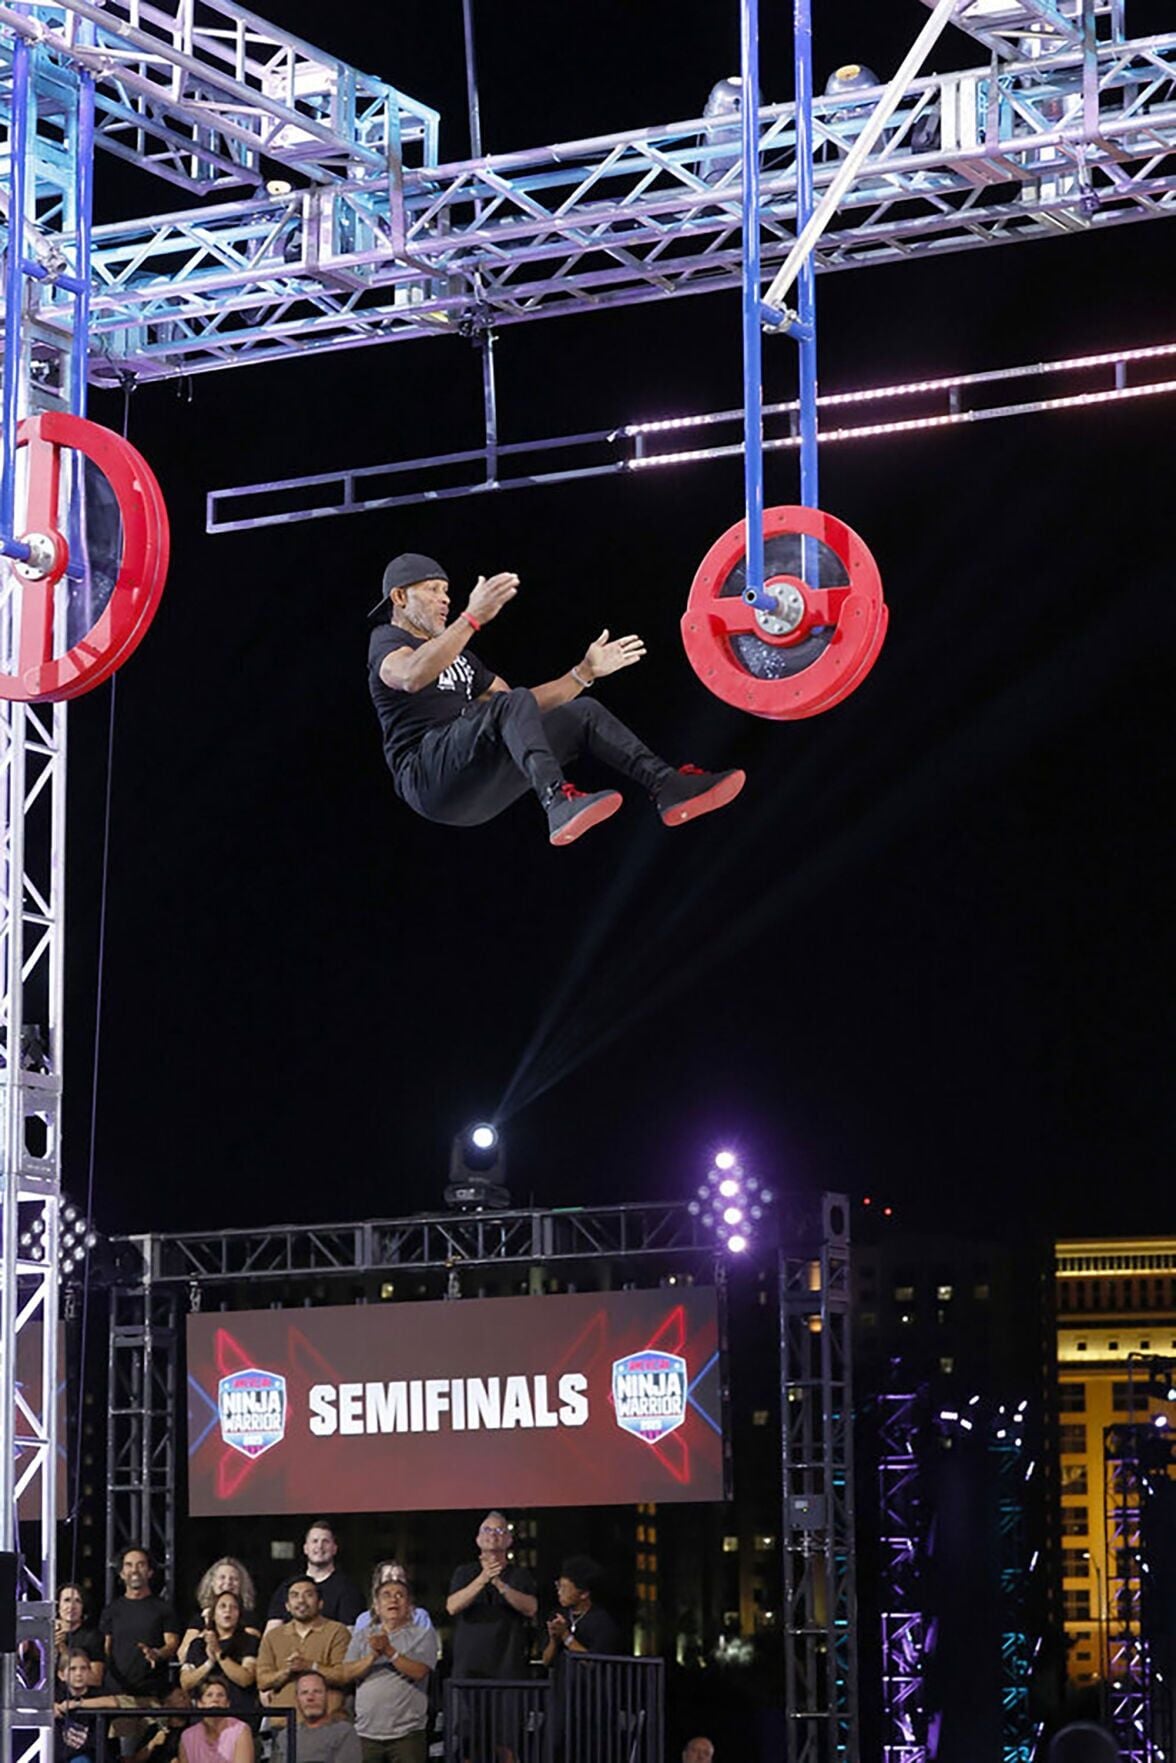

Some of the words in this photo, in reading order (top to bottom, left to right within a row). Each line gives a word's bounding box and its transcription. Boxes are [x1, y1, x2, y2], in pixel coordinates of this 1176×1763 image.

[616, 1373, 682, 1397] NINJA
[222, 1389, 282, 1413] NINJA
[308, 1373, 589, 1436] SEMIFINALS
[618, 1396, 682, 1416] WARRIOR
[222, 1413, 282, 1432] WARRIOR
